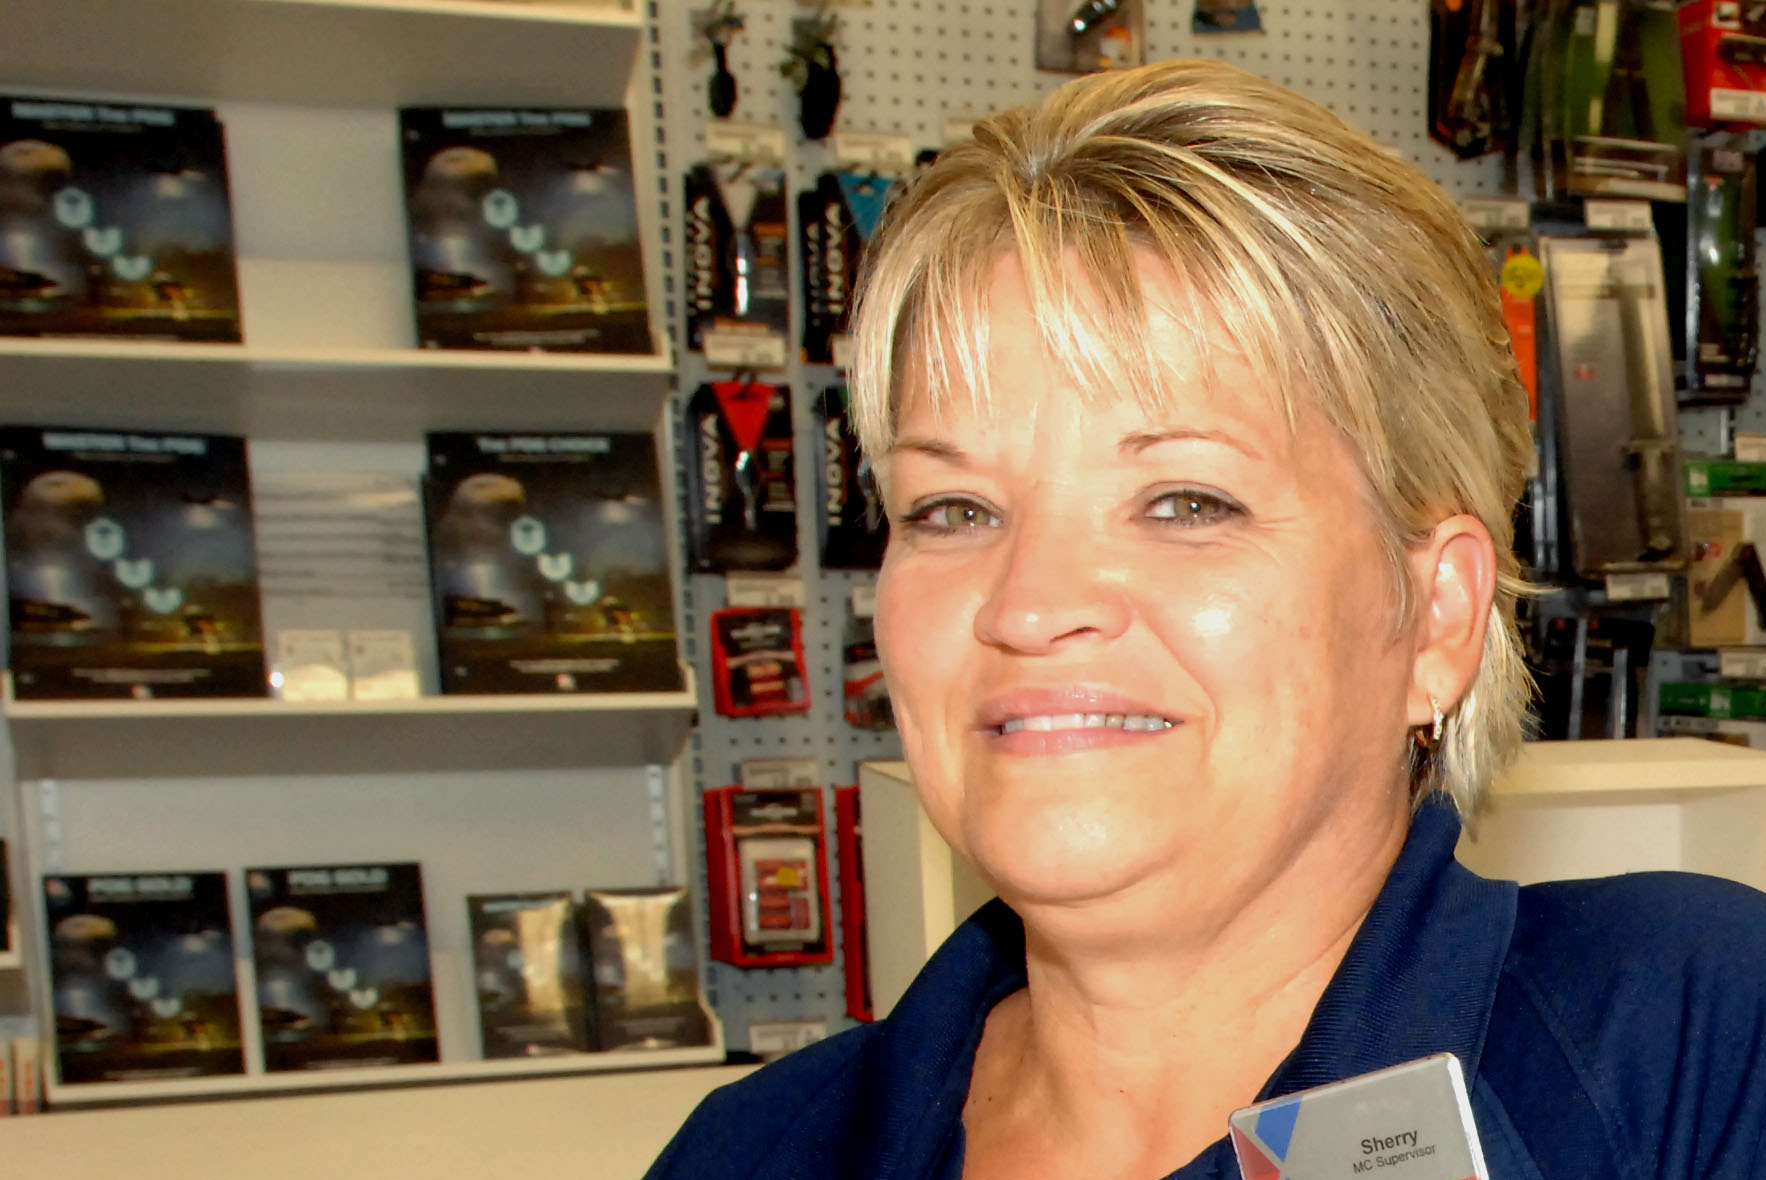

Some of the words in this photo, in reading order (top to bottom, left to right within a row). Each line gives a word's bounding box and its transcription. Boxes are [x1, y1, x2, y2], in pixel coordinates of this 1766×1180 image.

[694, 197, 711, 311] INOVA
[826, 202, 843, 314] INOVA
[701, 414, 722, 524] INOVA
[826, 418, 842, 526] INOVA
[1353, 1158, 1374, 1175] MC
[1376, 1143, 1437, 1172] Supervisor
[1361, 1128, 1419, 1155] Sherry
